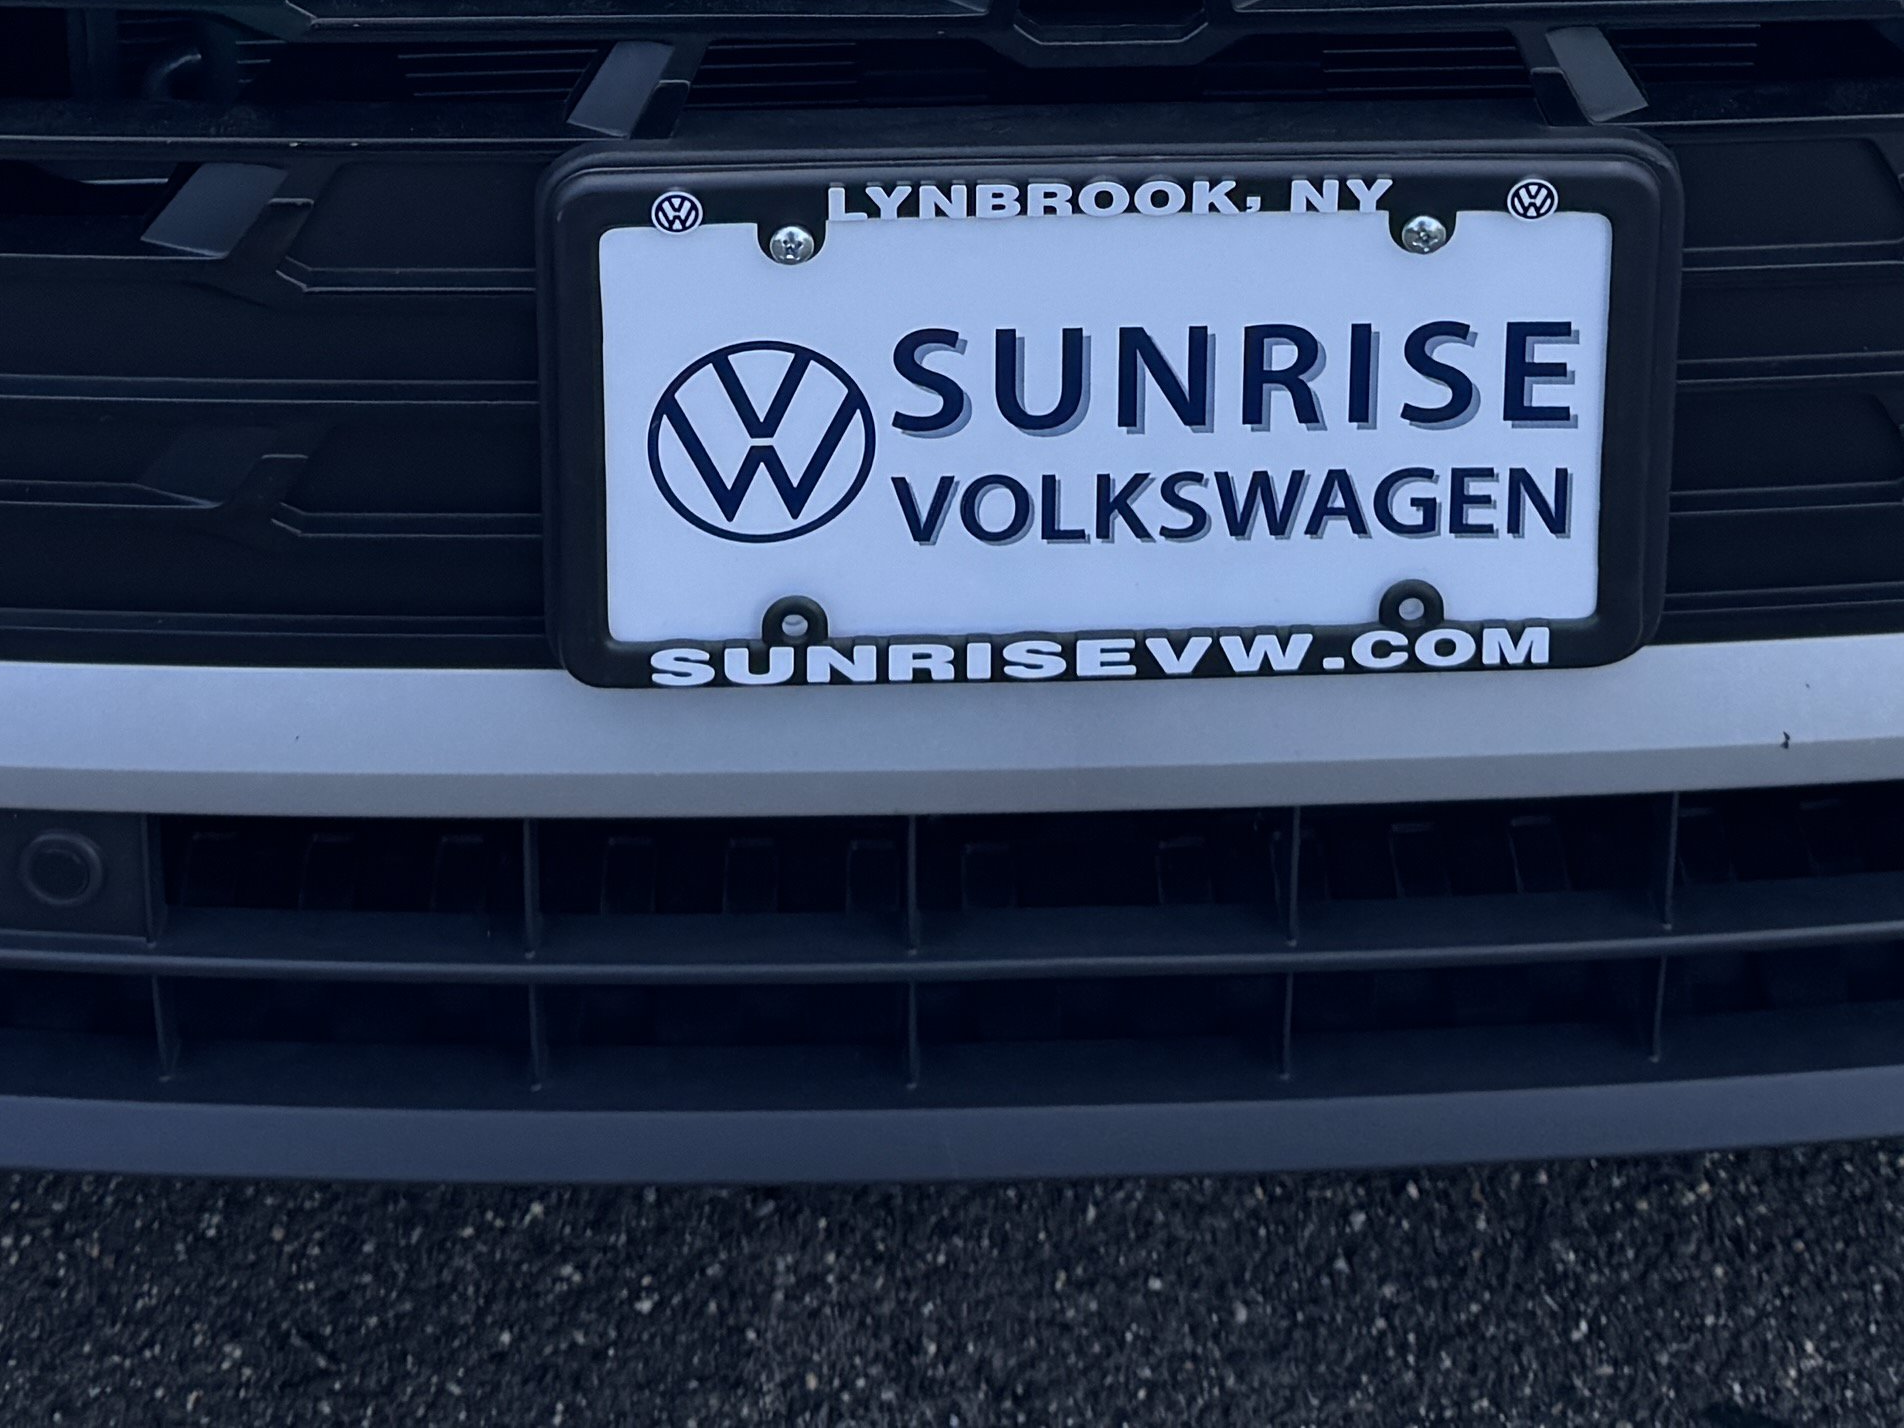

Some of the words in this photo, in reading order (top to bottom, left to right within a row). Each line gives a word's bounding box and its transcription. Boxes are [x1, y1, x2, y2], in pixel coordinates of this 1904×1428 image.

[827, 178, 1262, 222] LYNBROOK,
[1290, 178, 1394, 213] NY
[891, 321, 1578, 435] SUNRISE
[647, 340, 876, 543] VW
[891, 467, 1572, 544] VOLKSWAGEN
[650, 627, 1551, 687] SUNRISEVW.COM
